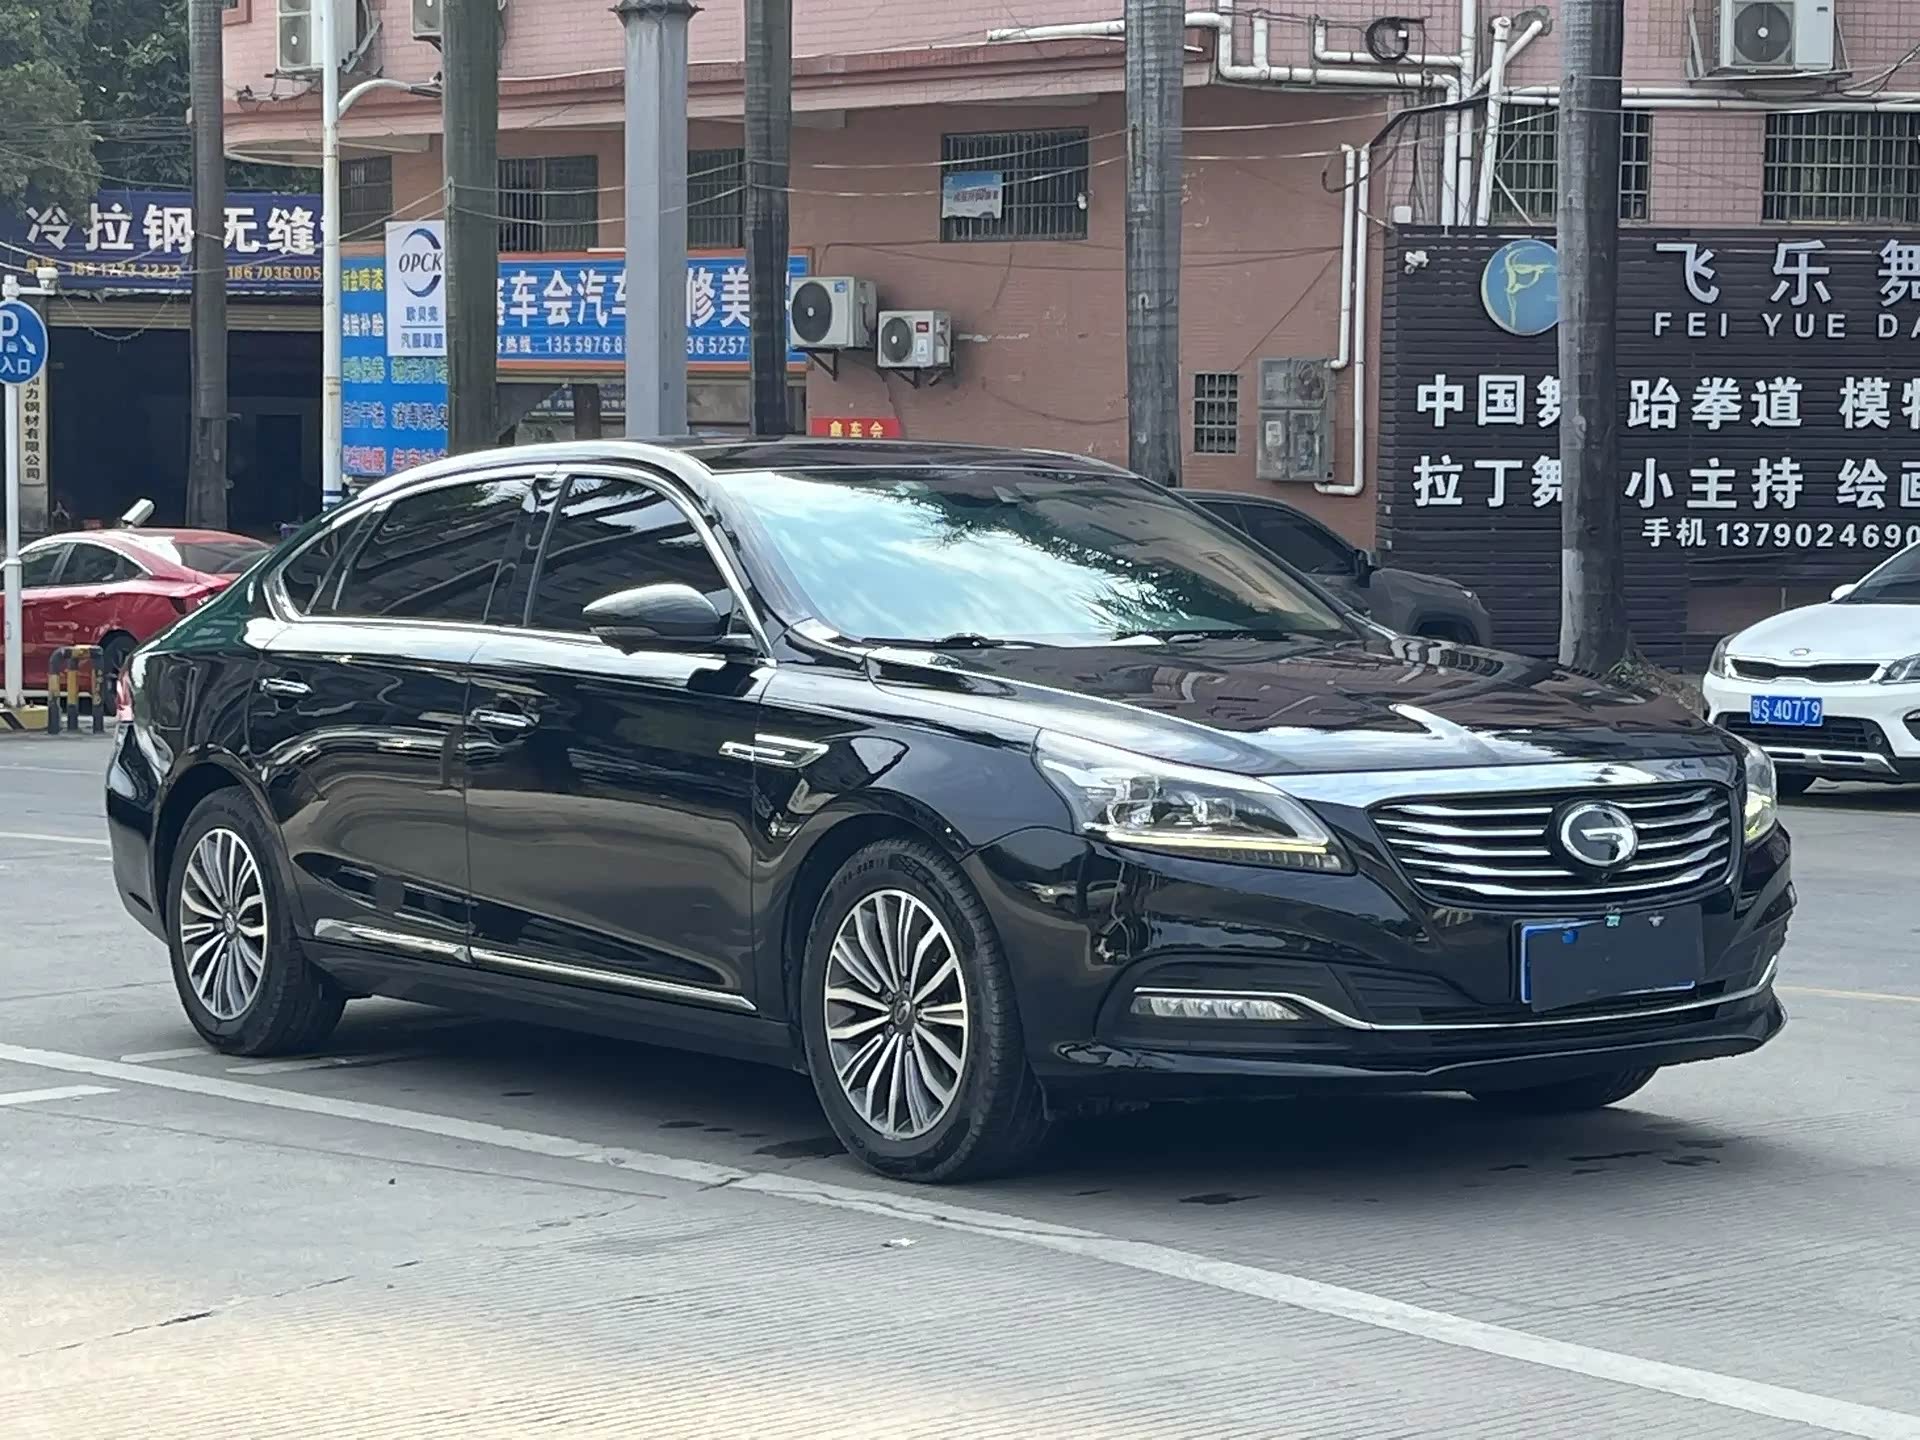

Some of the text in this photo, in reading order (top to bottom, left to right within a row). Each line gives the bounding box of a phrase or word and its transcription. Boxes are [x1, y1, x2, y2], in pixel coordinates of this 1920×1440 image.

[223, 206, 323, 255] 无缝
[399, 252, 443, 273] OPCK
[1654, 312, 1728, 337] FEI
[1762, 313, 1846, 338] YUE
[708, 336, 746, 354] 5257
[0, 355, 31, 375] 入口
[1627, 377, 1803, 430] 跆拳道
[1624, 457, 1803, 510] 小主持
[1642, 517, 1706, 547] 手机
